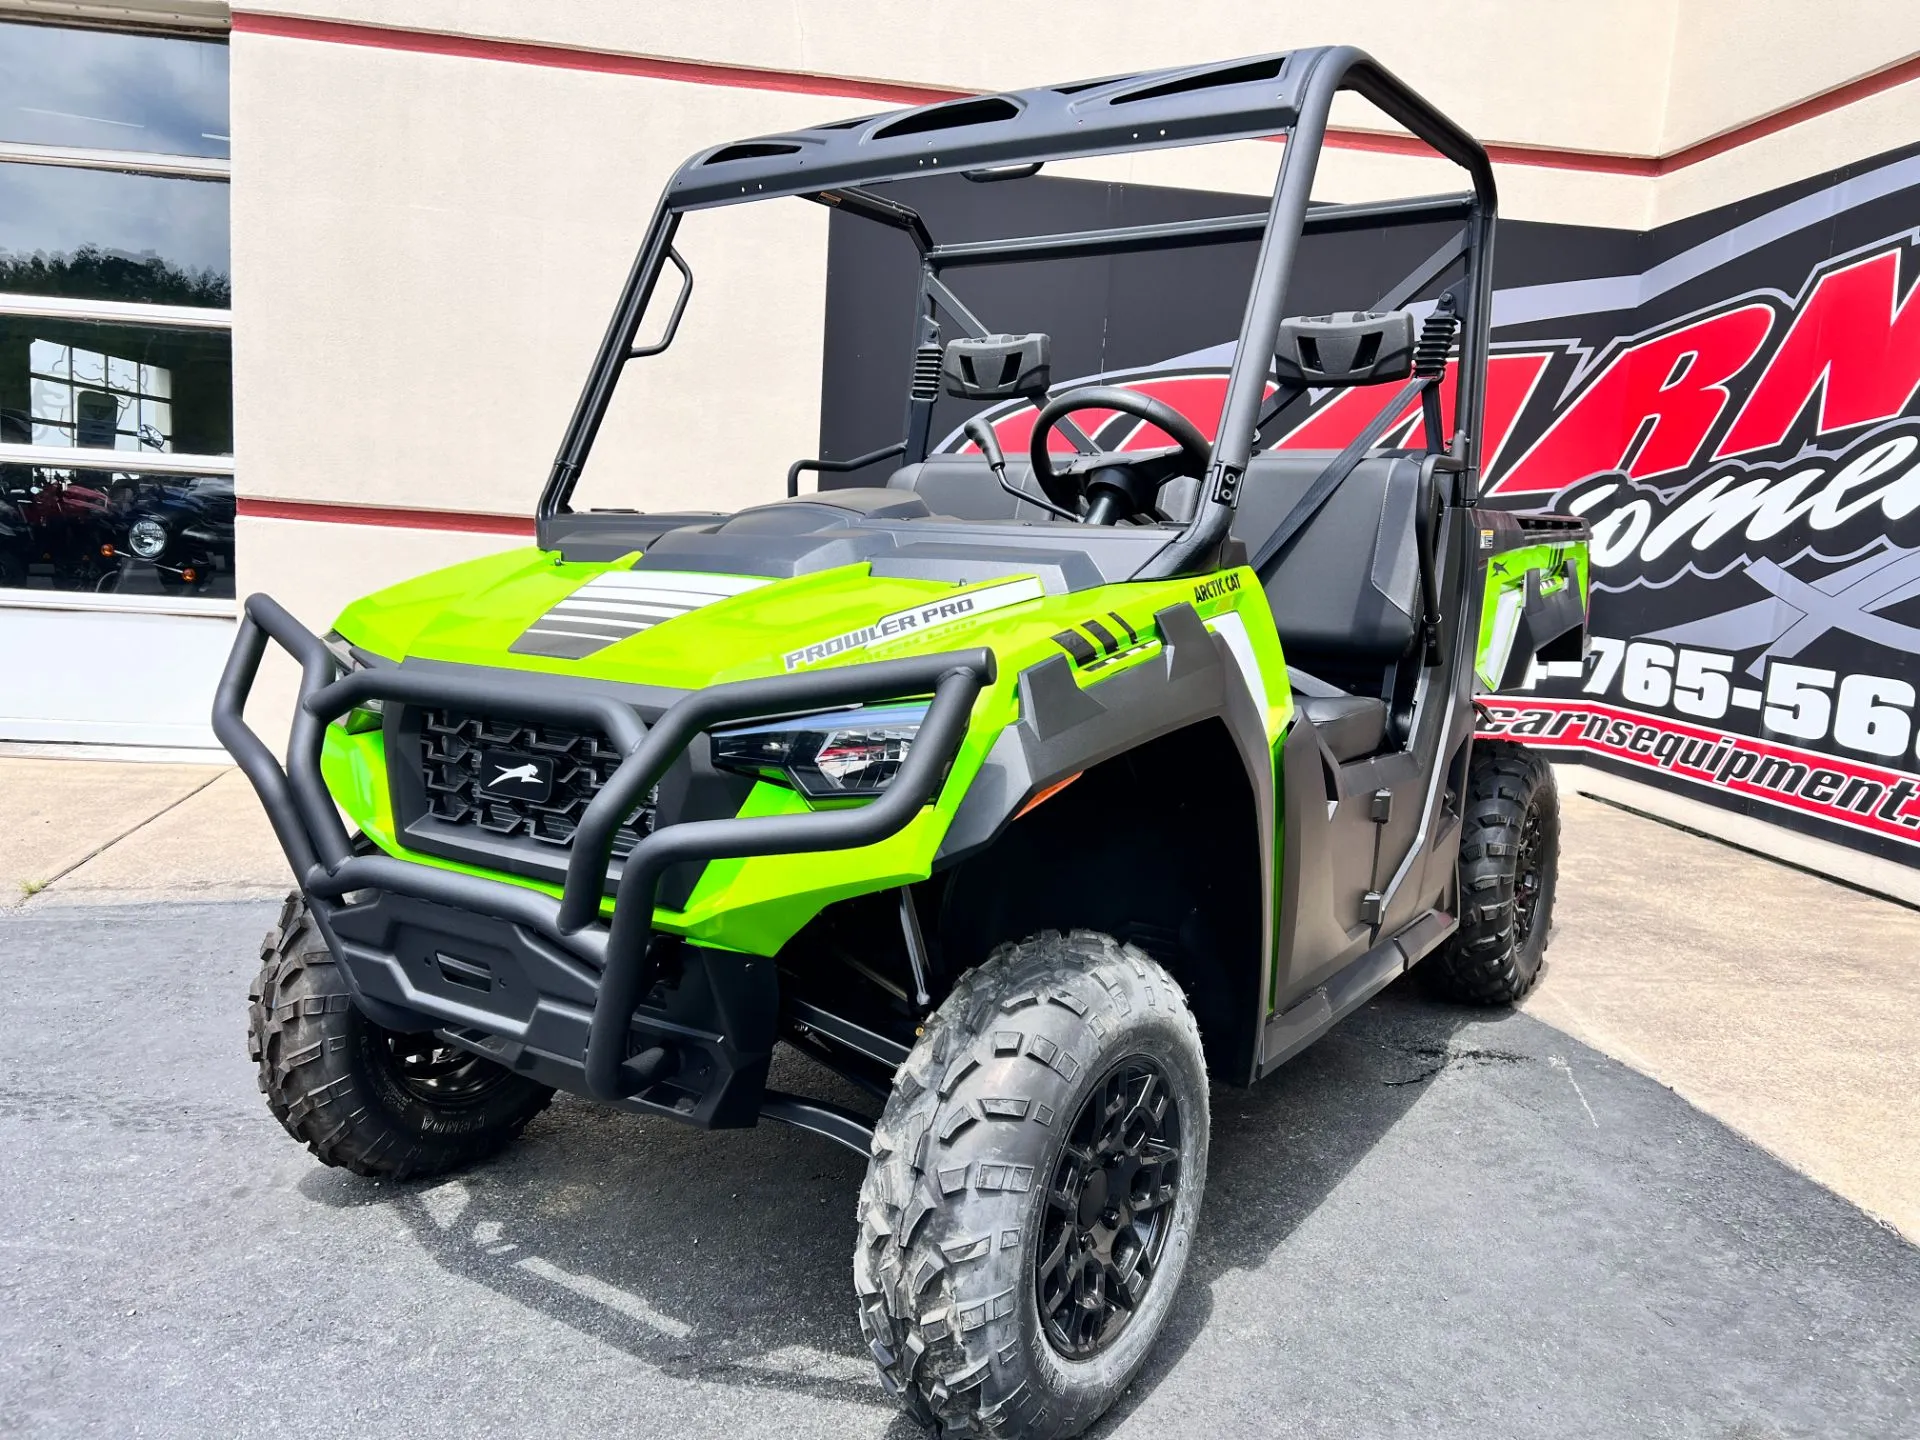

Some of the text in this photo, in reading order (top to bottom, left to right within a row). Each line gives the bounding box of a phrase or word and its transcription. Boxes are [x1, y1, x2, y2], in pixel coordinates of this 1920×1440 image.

[1569, 436, 1920, 568] ome
[784, 598, 975, 670] PROWLER PRO
[1194, 572, 1241, 603] ARCTIC CAT
[1521, 636, 1920, 760] -765-56
